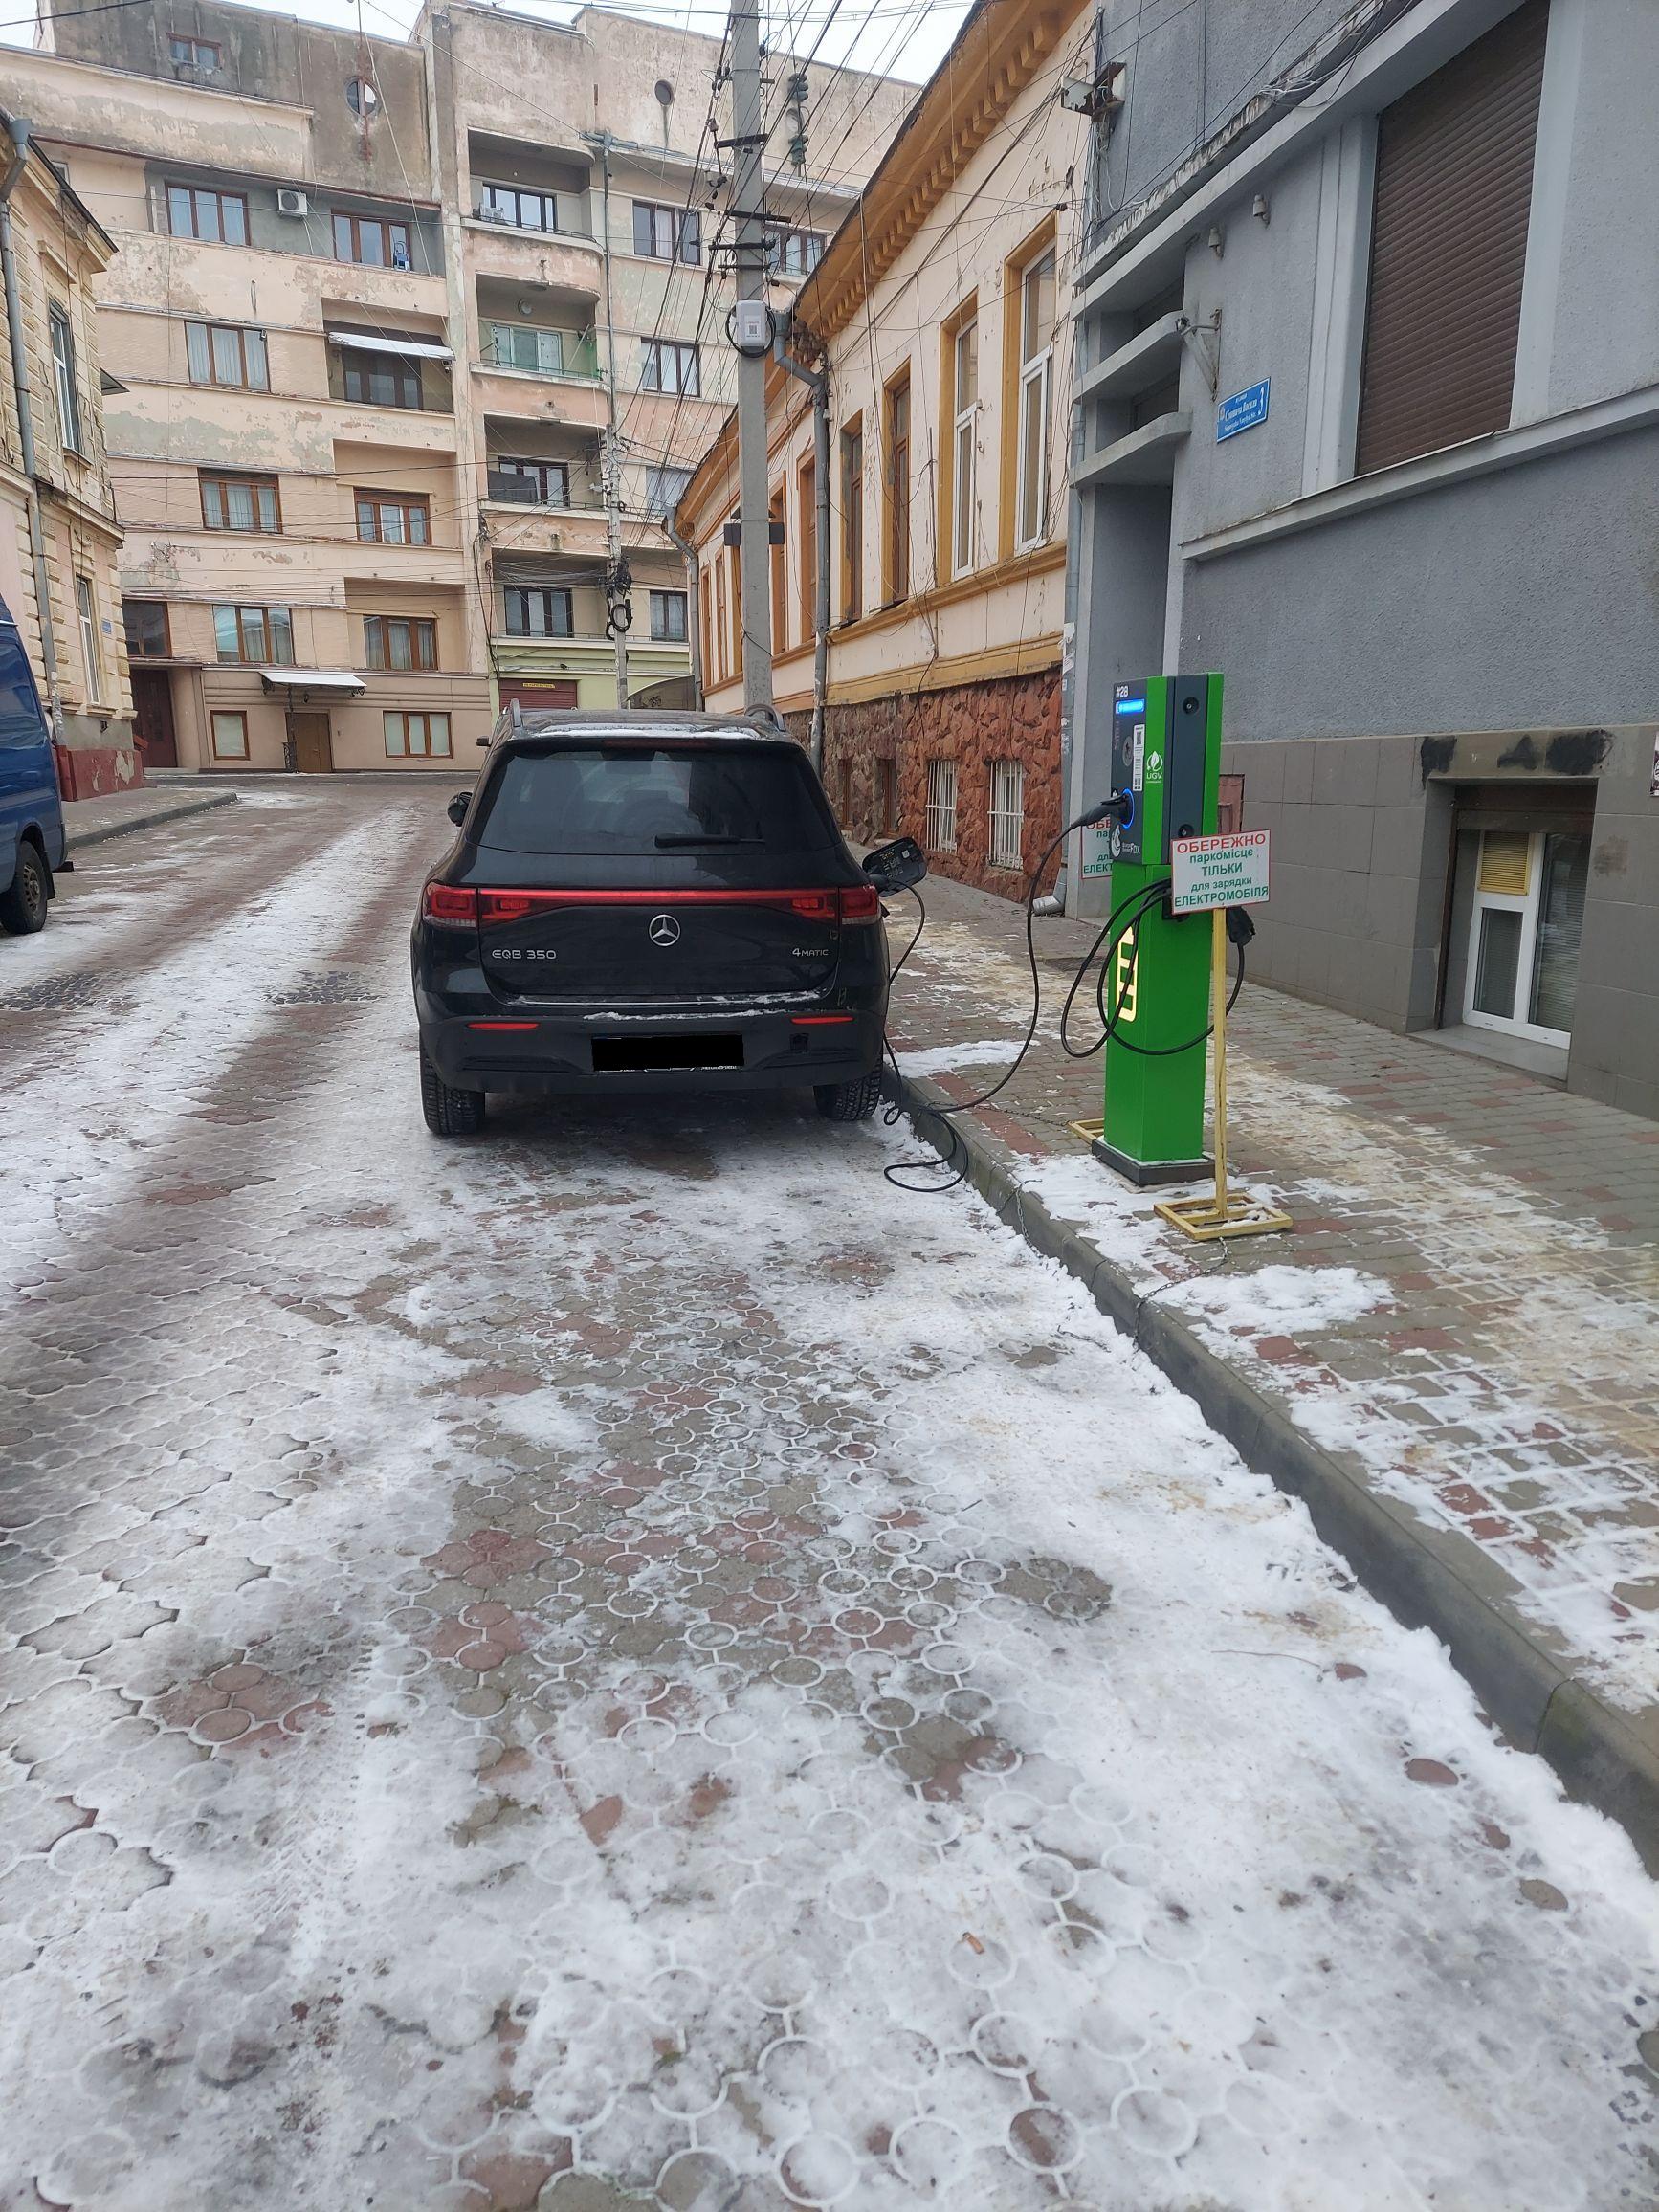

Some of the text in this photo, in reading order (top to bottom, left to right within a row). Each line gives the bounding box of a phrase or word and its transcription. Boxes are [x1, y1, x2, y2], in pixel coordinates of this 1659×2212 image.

[1177, 833, 1266, 853] ОБЕРЕЖНО
[1189, 849, 1253, 864] паркомісце
[1083, 863, 1113, 874] ЕЛЕКТ
[1201, 862, 1243, 876] ТІЛЬКИ
[1190, 877, 1252, 893] для зарядки
[1174, 886, 1269, 907] ЕЛЕКТРОМОБІЛЯ
[492, 949, 557, 959] EQB 350
[792, 947, 829, 957] 4MATIC
